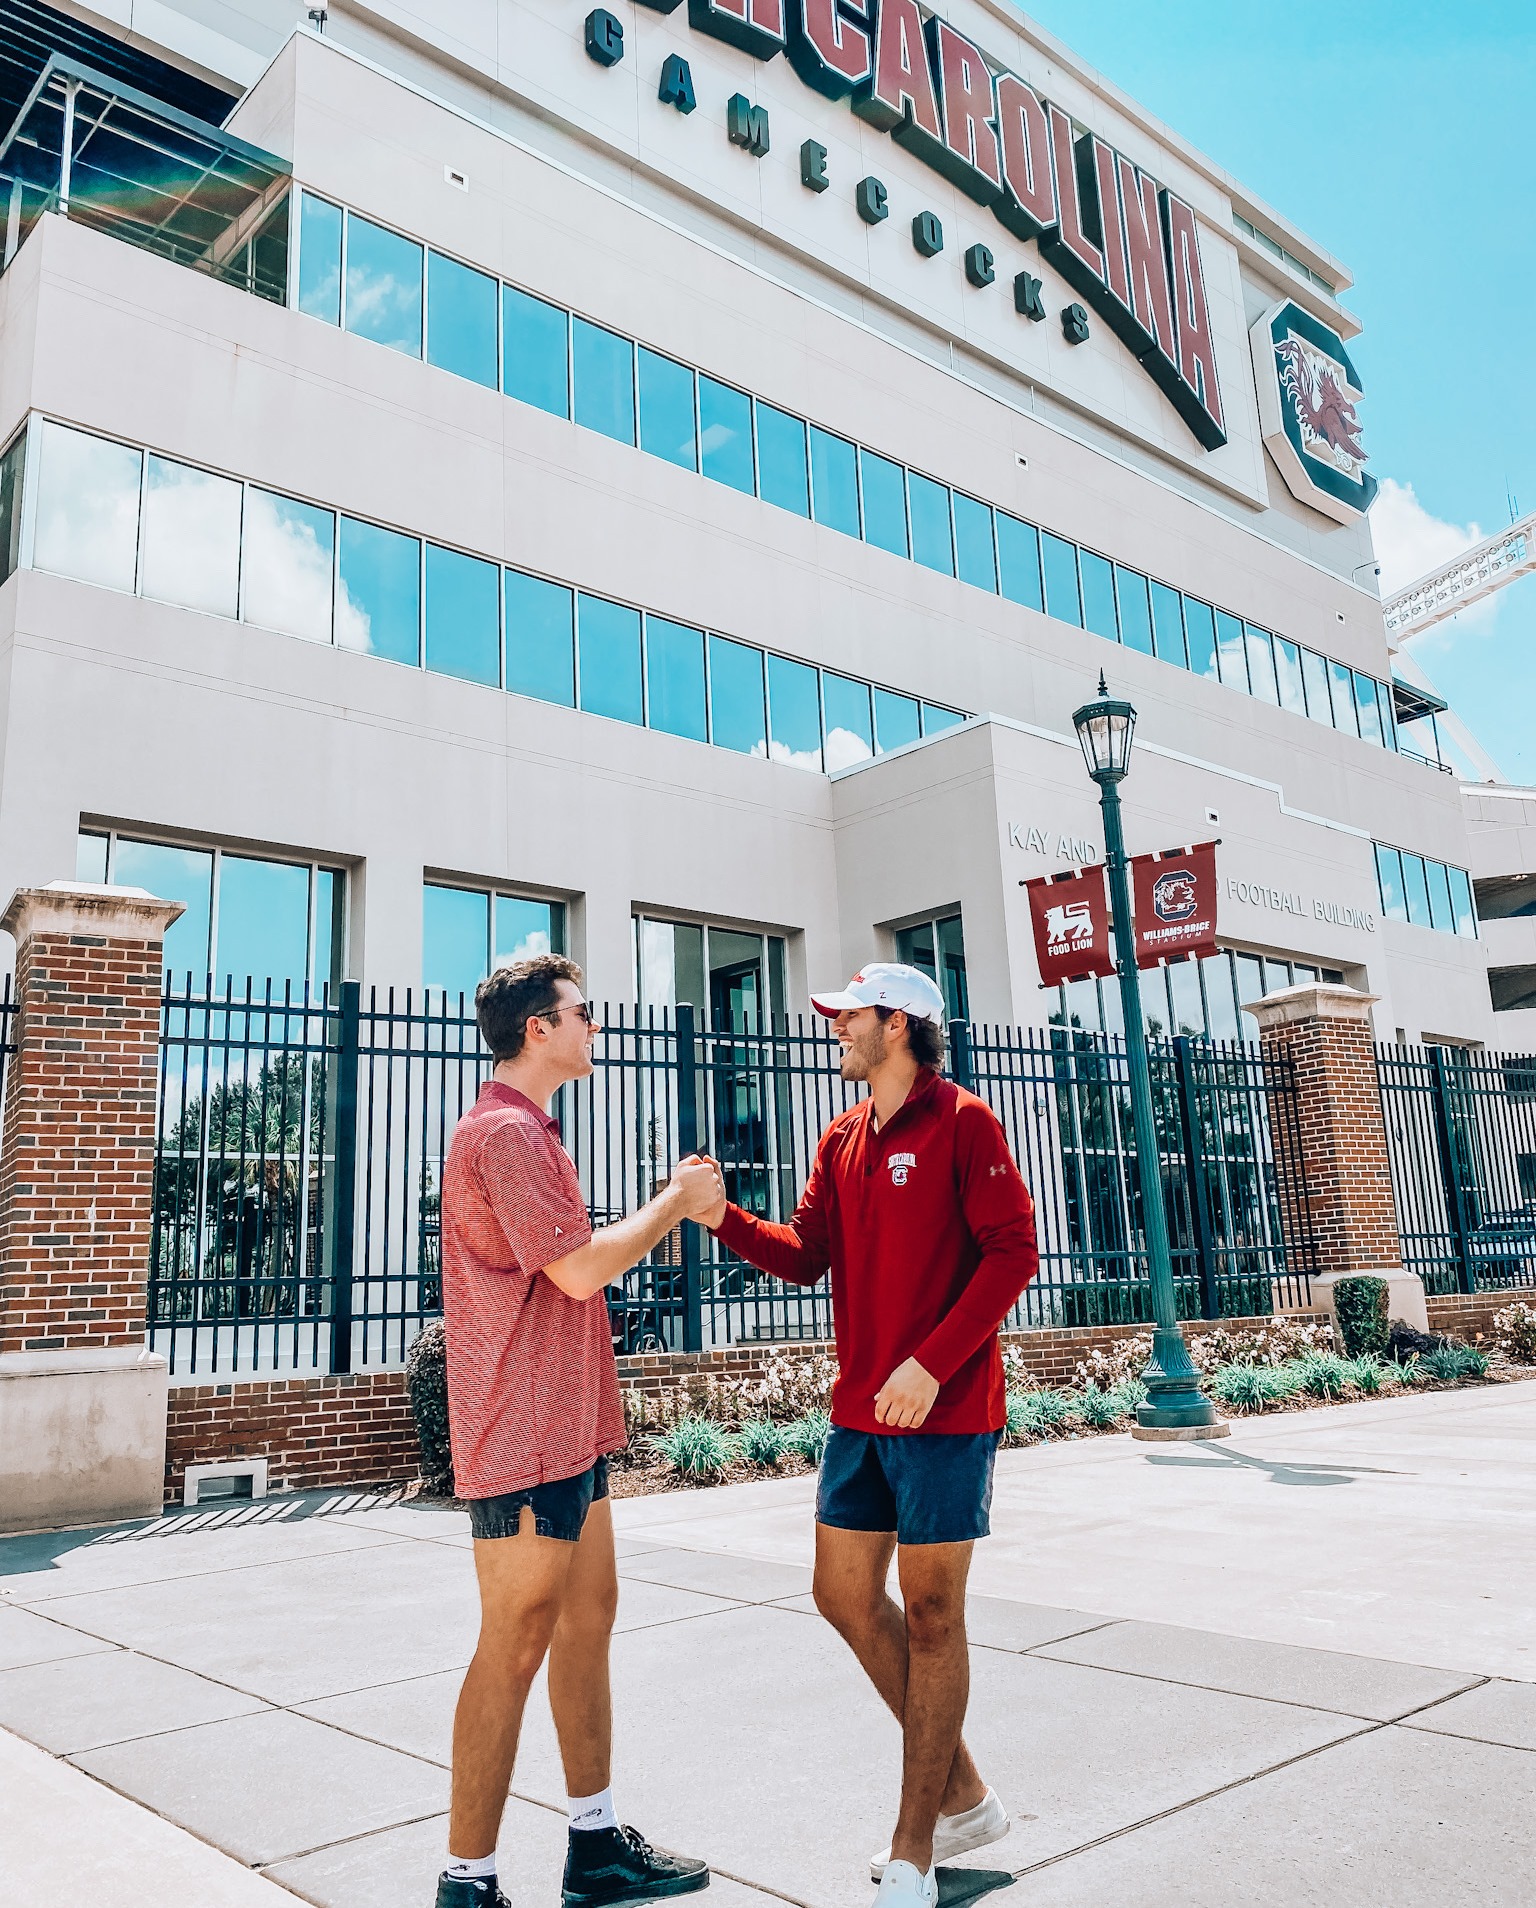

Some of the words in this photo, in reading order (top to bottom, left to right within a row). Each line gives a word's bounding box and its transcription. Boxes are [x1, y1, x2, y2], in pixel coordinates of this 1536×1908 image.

[584, 8, 1091, 345] GAMECOCKS
[1008, 821, 1051, 855] KAY
[1056, 834, 1098, 865] AND
[1226, 877, 1308, 917] FOOTBALL
[1312, 898, 1375, 932] BUILDING
[1143, 921, 1210, 941] WILLIAMS-BRICE
[1149, 932, 1202, 946] STADIUM
[1048, 942, 1070, 957] FOOD
[1072, 938, 1093, 952] LION
